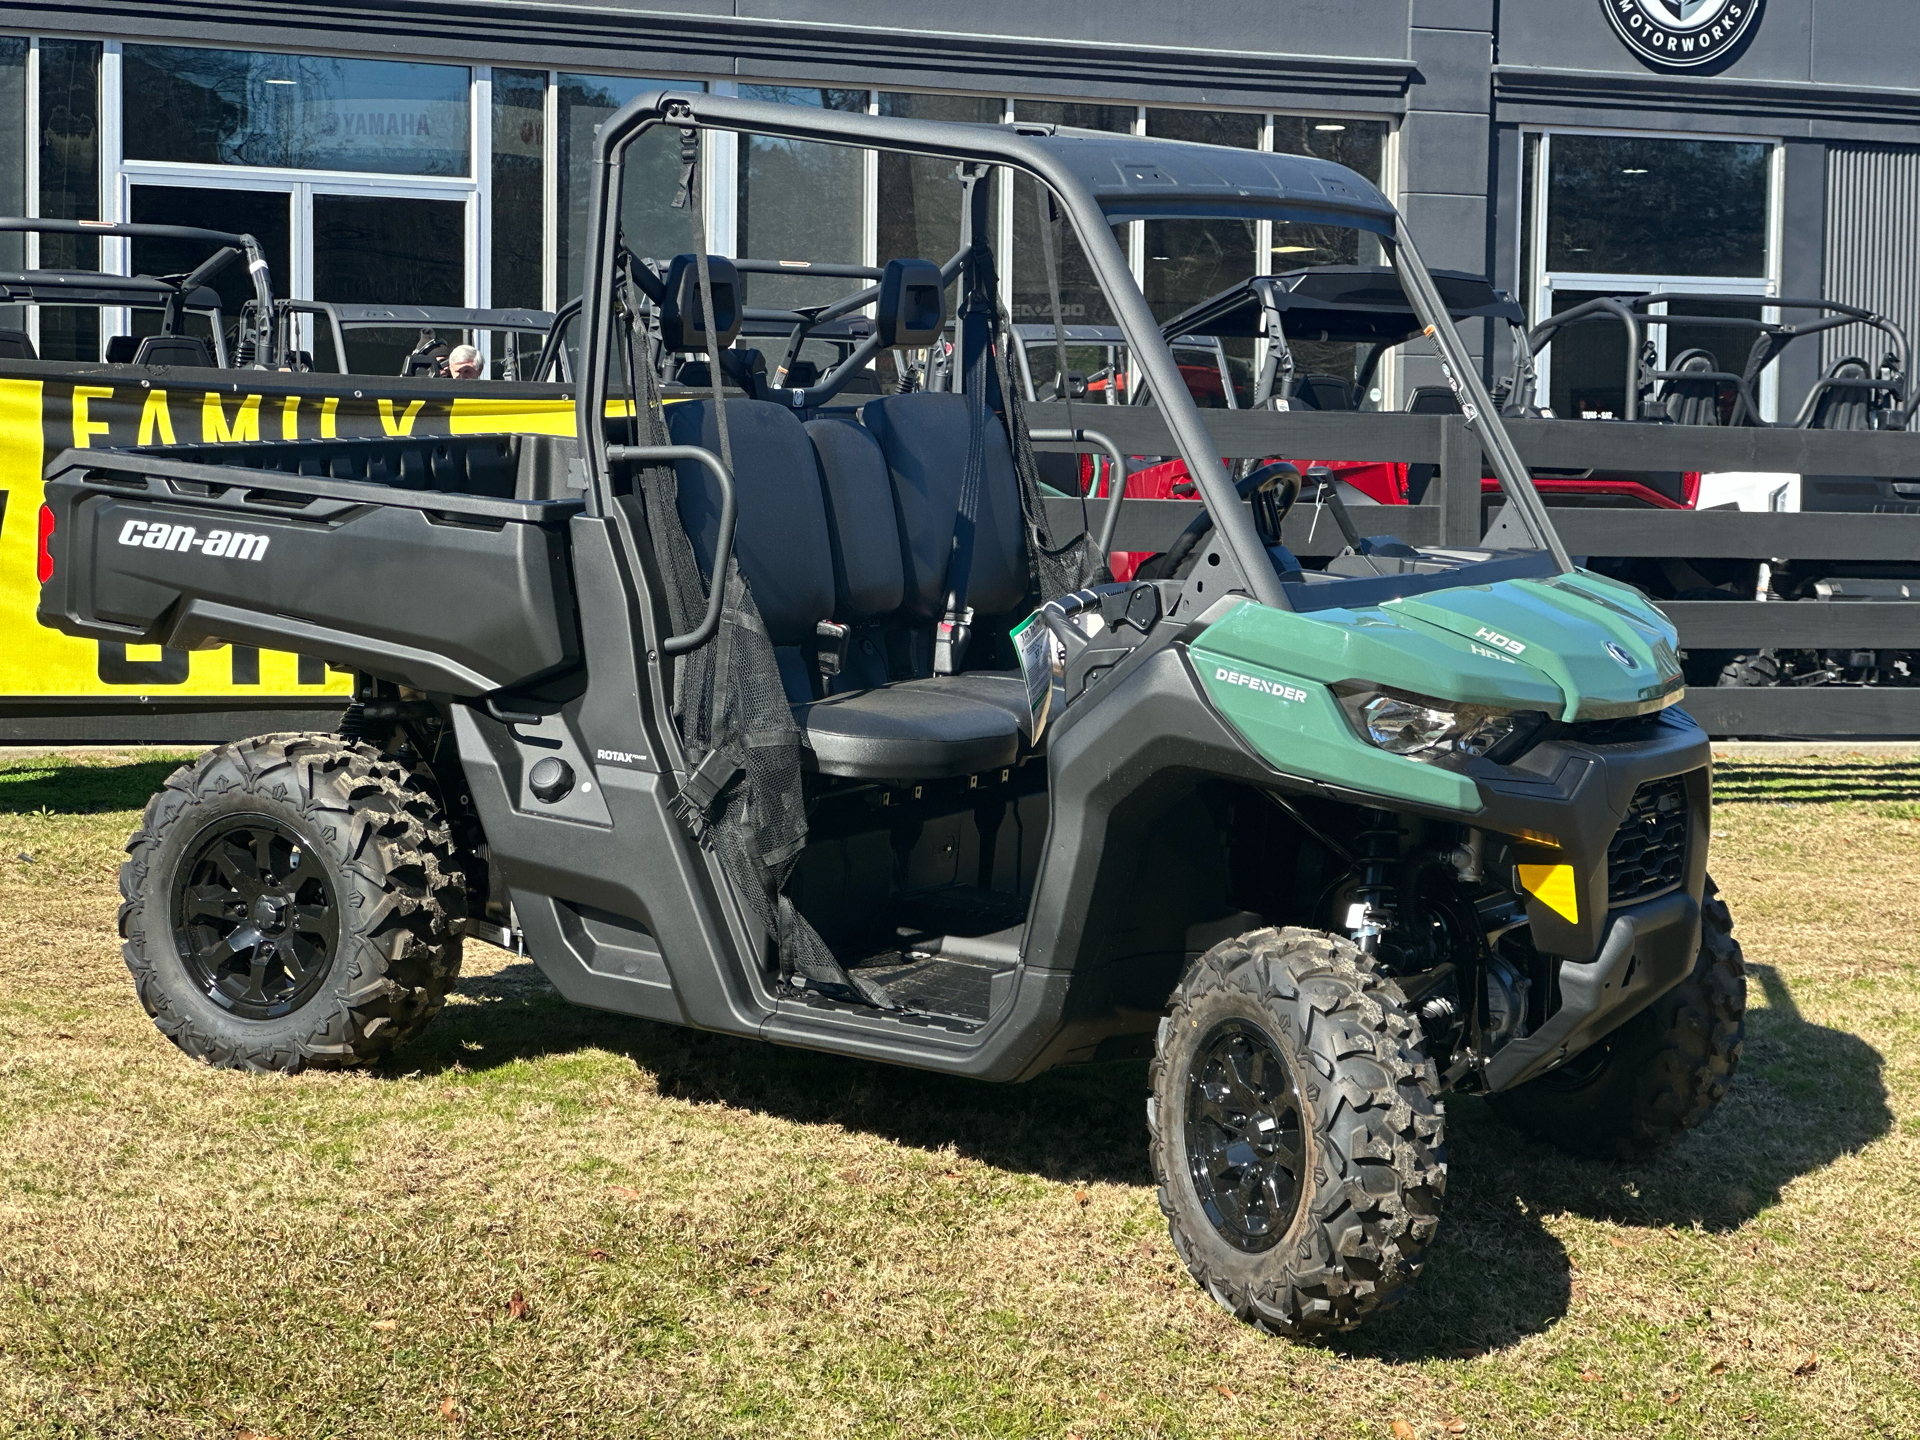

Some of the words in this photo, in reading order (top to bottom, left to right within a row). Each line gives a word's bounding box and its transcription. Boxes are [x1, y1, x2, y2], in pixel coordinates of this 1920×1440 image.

[1619, 0, 1742, 51] MOTORWORKS
[343, 113, 430, 136] YAMAHA
[118, 519, 270, 561] can-am
[1475, 626, 1526, 655] HD9
[1215, 667, 1307, 703] DEFENDER
[597, 749, 632, 763] ROTAX
